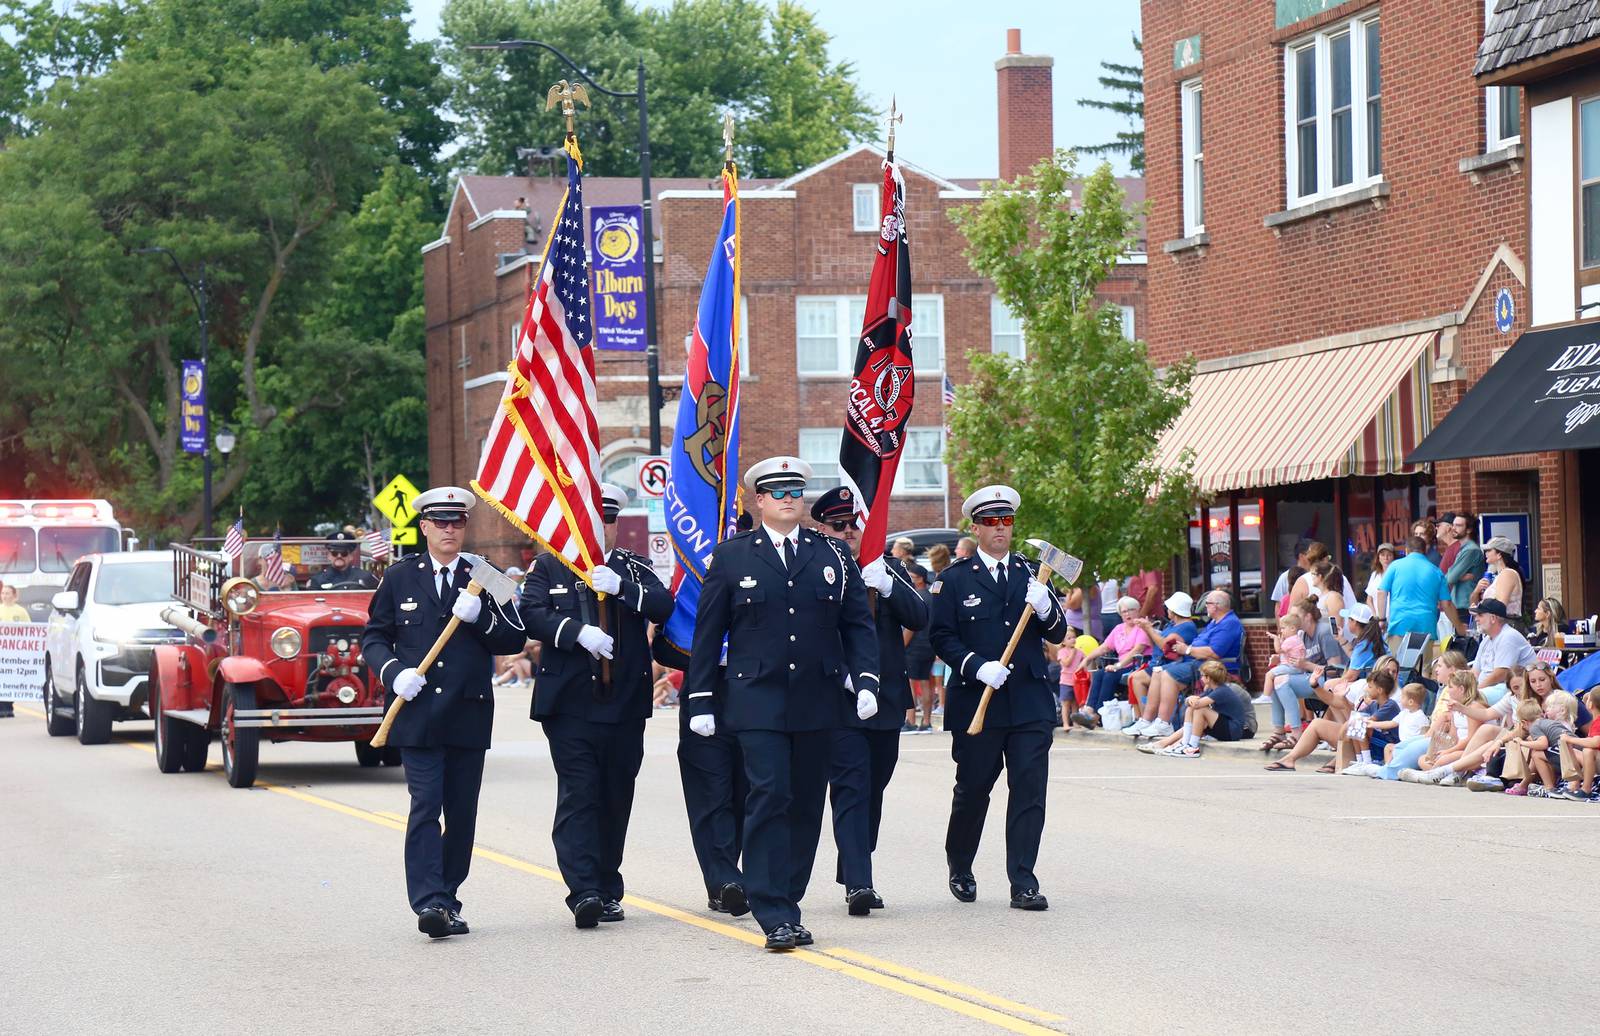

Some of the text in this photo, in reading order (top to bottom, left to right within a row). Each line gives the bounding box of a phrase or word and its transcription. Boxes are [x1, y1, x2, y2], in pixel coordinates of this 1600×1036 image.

[595, 268, 643, 294] Elburn
[603, 294, 637, 325] Days
[598, 327, 615, 335] Third
[863, 336, 876, 352] EST.
[1545, 376, 1600, 396] PUB A
[848, 379, 876, 418] OCAL
[0, 626, 48, 638] COUNTRYS
[1, 657, 31, 665] tember
[0, 667, 38, 677] am-12pm
